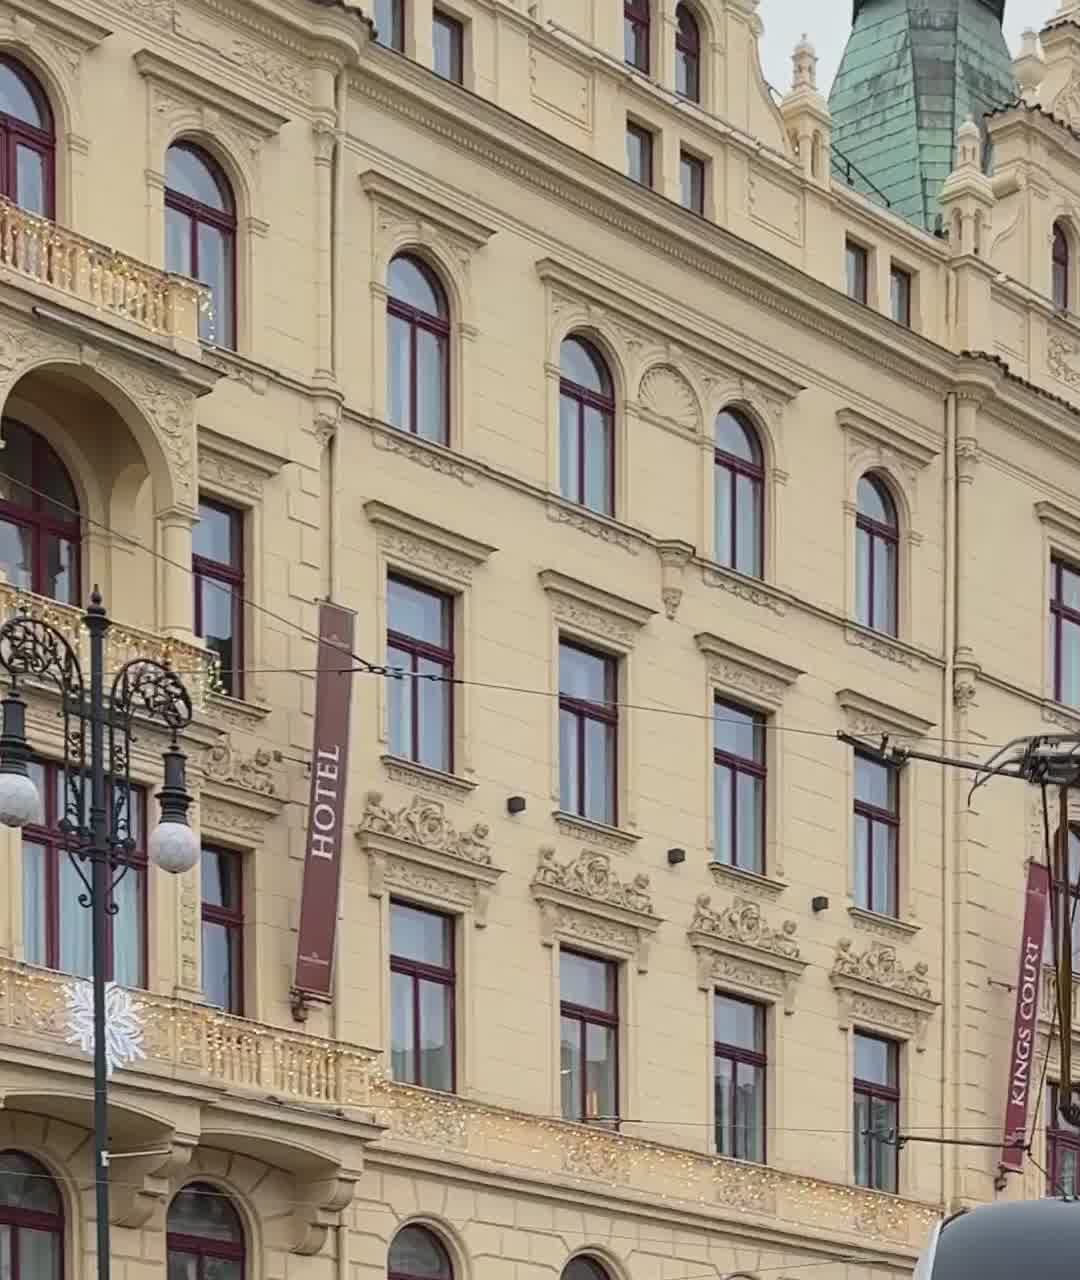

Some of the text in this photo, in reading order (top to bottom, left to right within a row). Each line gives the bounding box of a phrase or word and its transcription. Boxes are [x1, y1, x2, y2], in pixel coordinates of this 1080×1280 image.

[310, 744, 340, 861] HOTEL
[1011, 936, 1041, 1107] KINGS COURT
